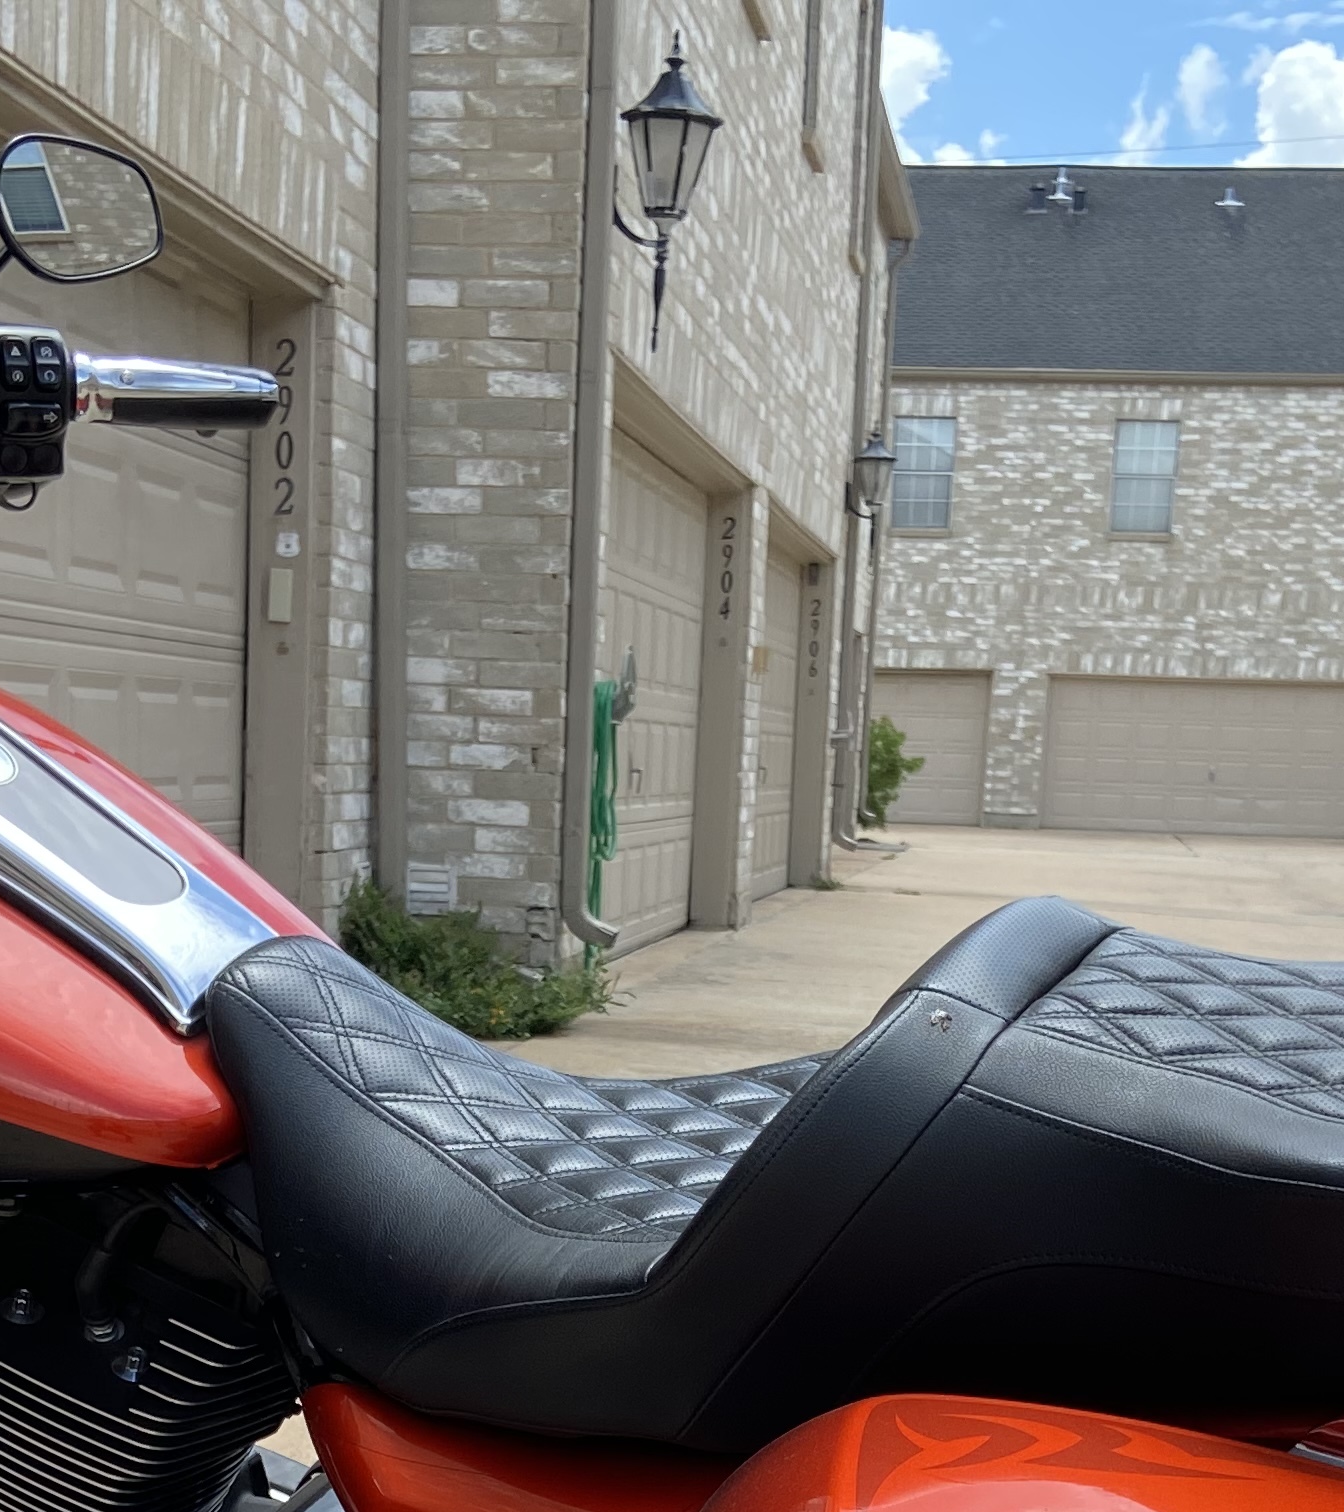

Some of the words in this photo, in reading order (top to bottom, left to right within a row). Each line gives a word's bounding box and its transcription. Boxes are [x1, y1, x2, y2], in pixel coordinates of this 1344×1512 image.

[273, 337, 297, 517] 2902
[718, 516, 737, 621] 2904
[808, 598, 822, 678] 2906
